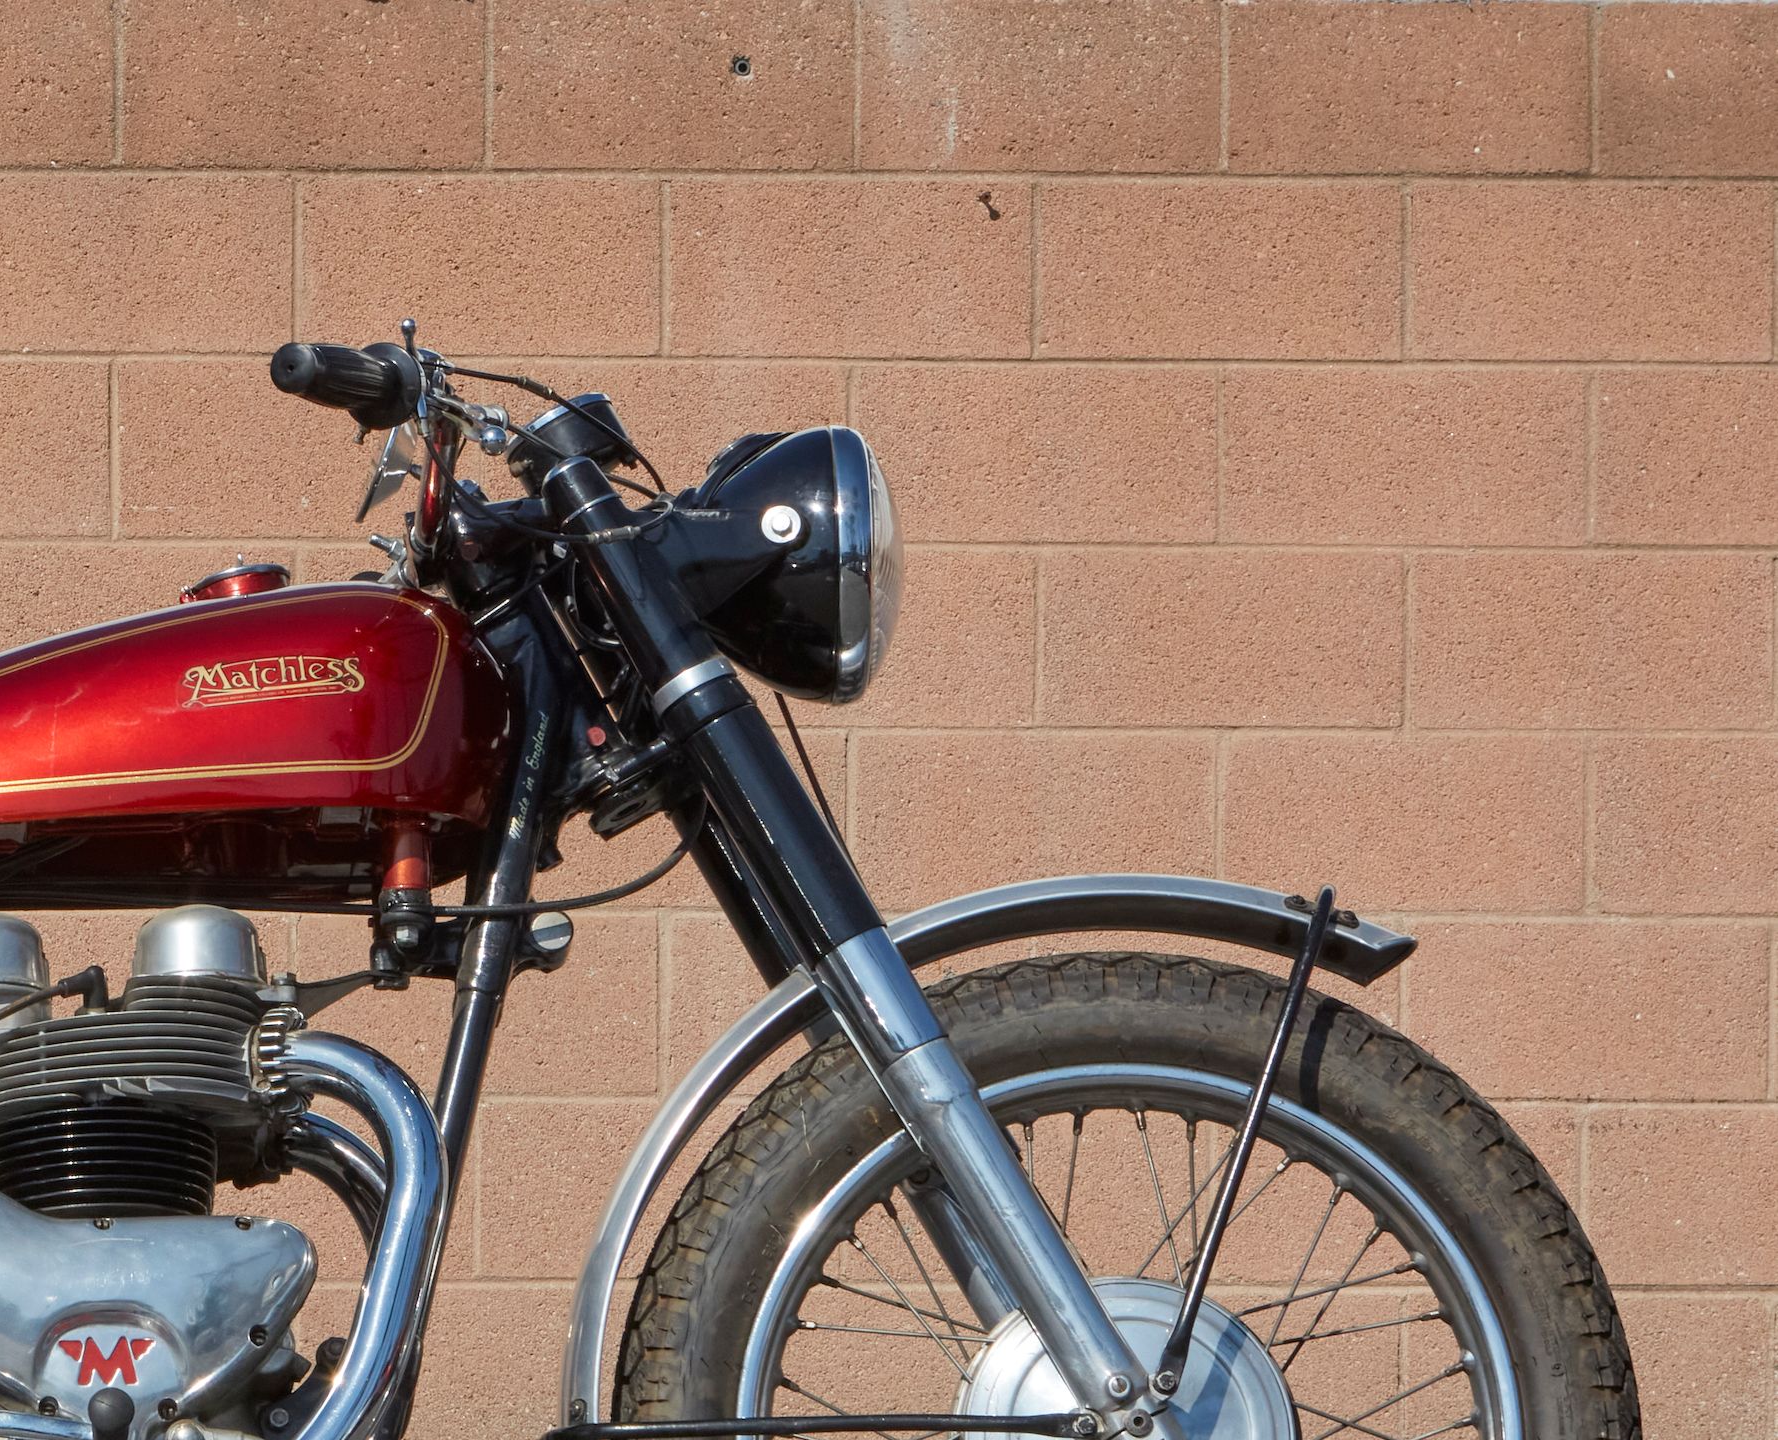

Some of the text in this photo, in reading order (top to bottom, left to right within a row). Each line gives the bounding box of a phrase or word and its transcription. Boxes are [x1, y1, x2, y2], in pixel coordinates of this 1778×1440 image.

[181, 655, 365, 709] Matchless
[508, 709, 550, 840] Made in England
[74, 1335, 140, 1387] M
